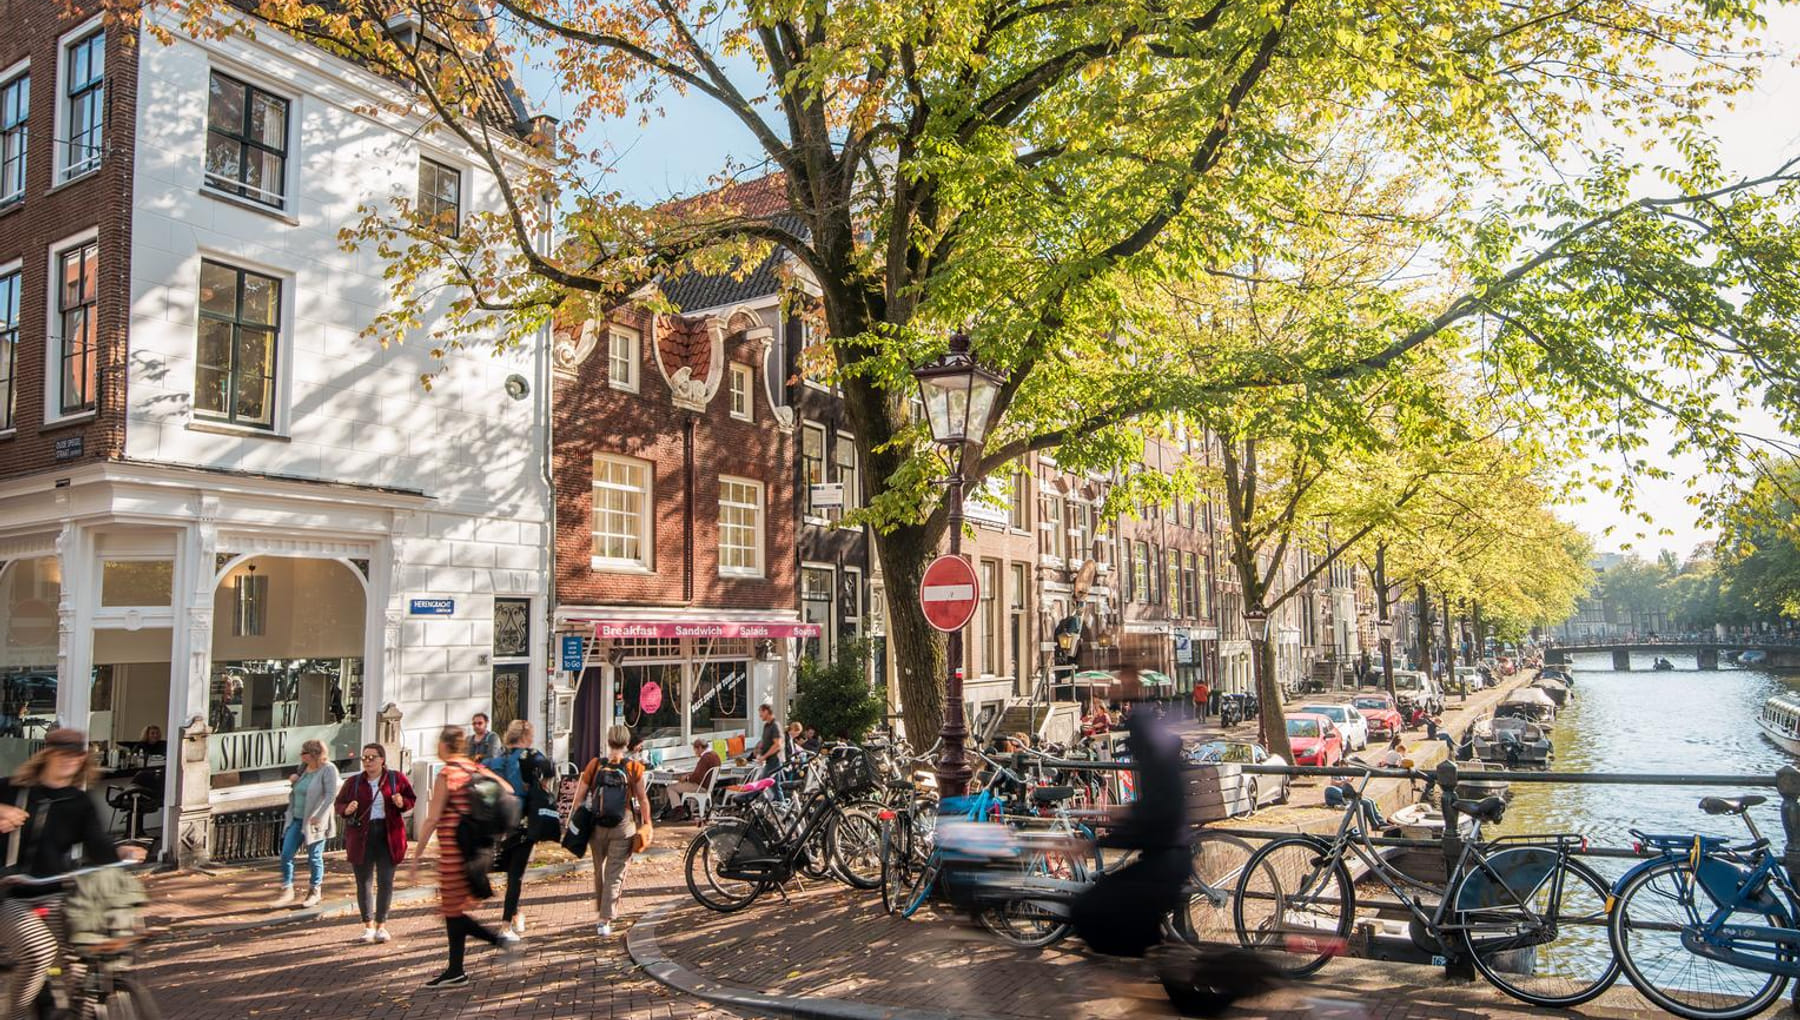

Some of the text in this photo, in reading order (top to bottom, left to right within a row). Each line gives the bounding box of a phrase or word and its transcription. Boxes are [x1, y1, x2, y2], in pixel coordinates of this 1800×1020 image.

[602, 625, 658, 636] Breakfast
[675, 625, 723, 637] Sandwich
[739, 626, 769, 637] Salads
[219, 731, 288, 770] SIMONE
